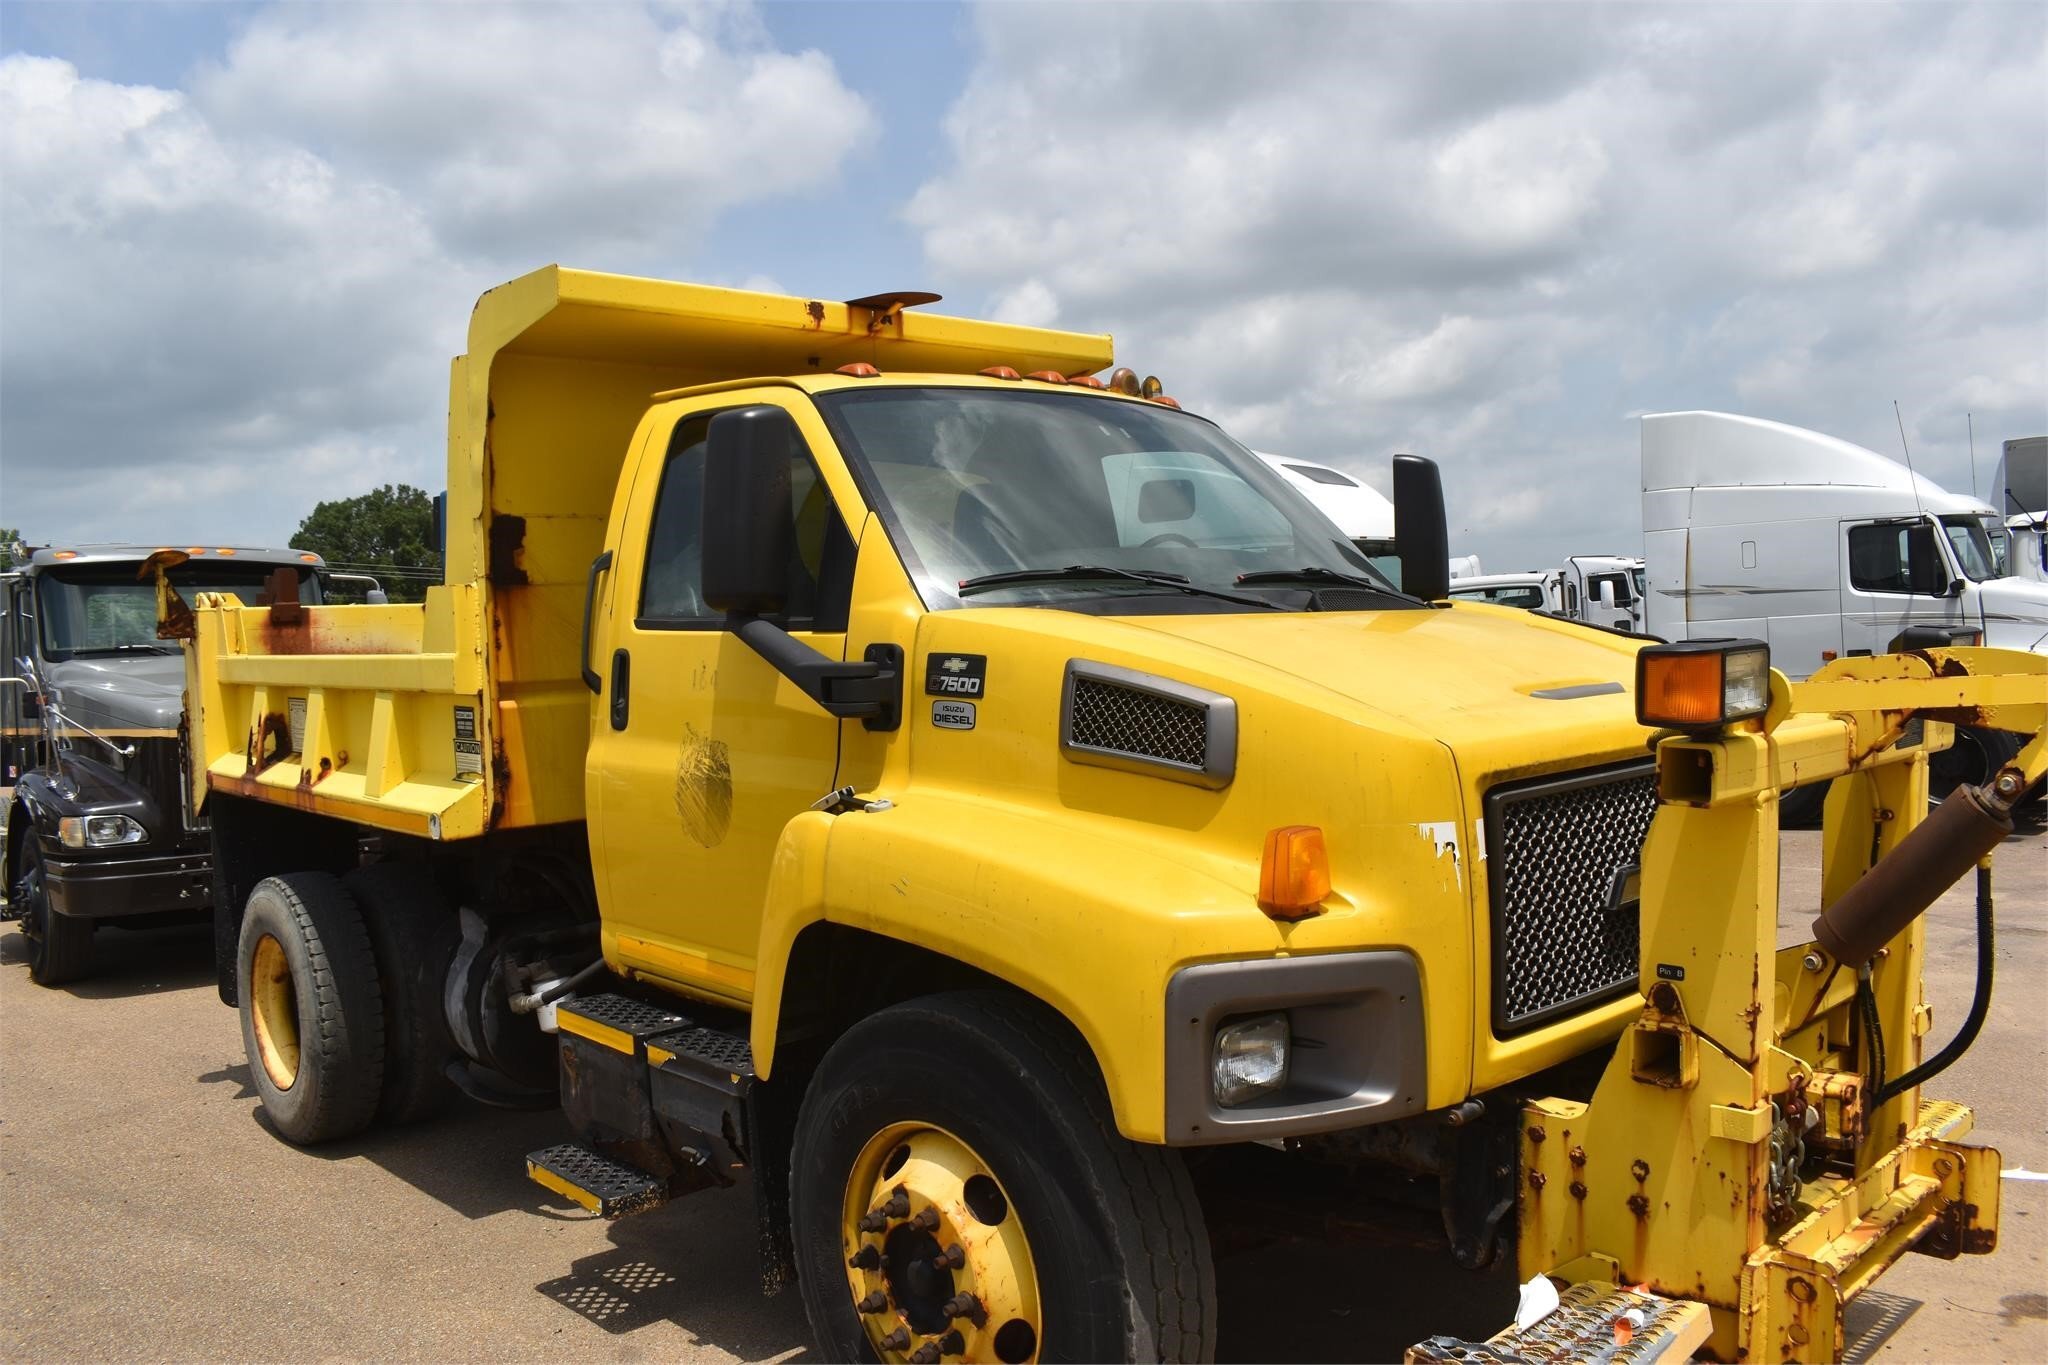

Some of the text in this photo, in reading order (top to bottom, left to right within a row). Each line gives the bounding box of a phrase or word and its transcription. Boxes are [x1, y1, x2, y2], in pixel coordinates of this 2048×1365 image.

[942, 705, 965, 713] ISUZU
[933, 713, 973, 725] DIESEL
[456, 742, 481, 754] CAUTION
[1659, 967, 1672, 975] Pin
